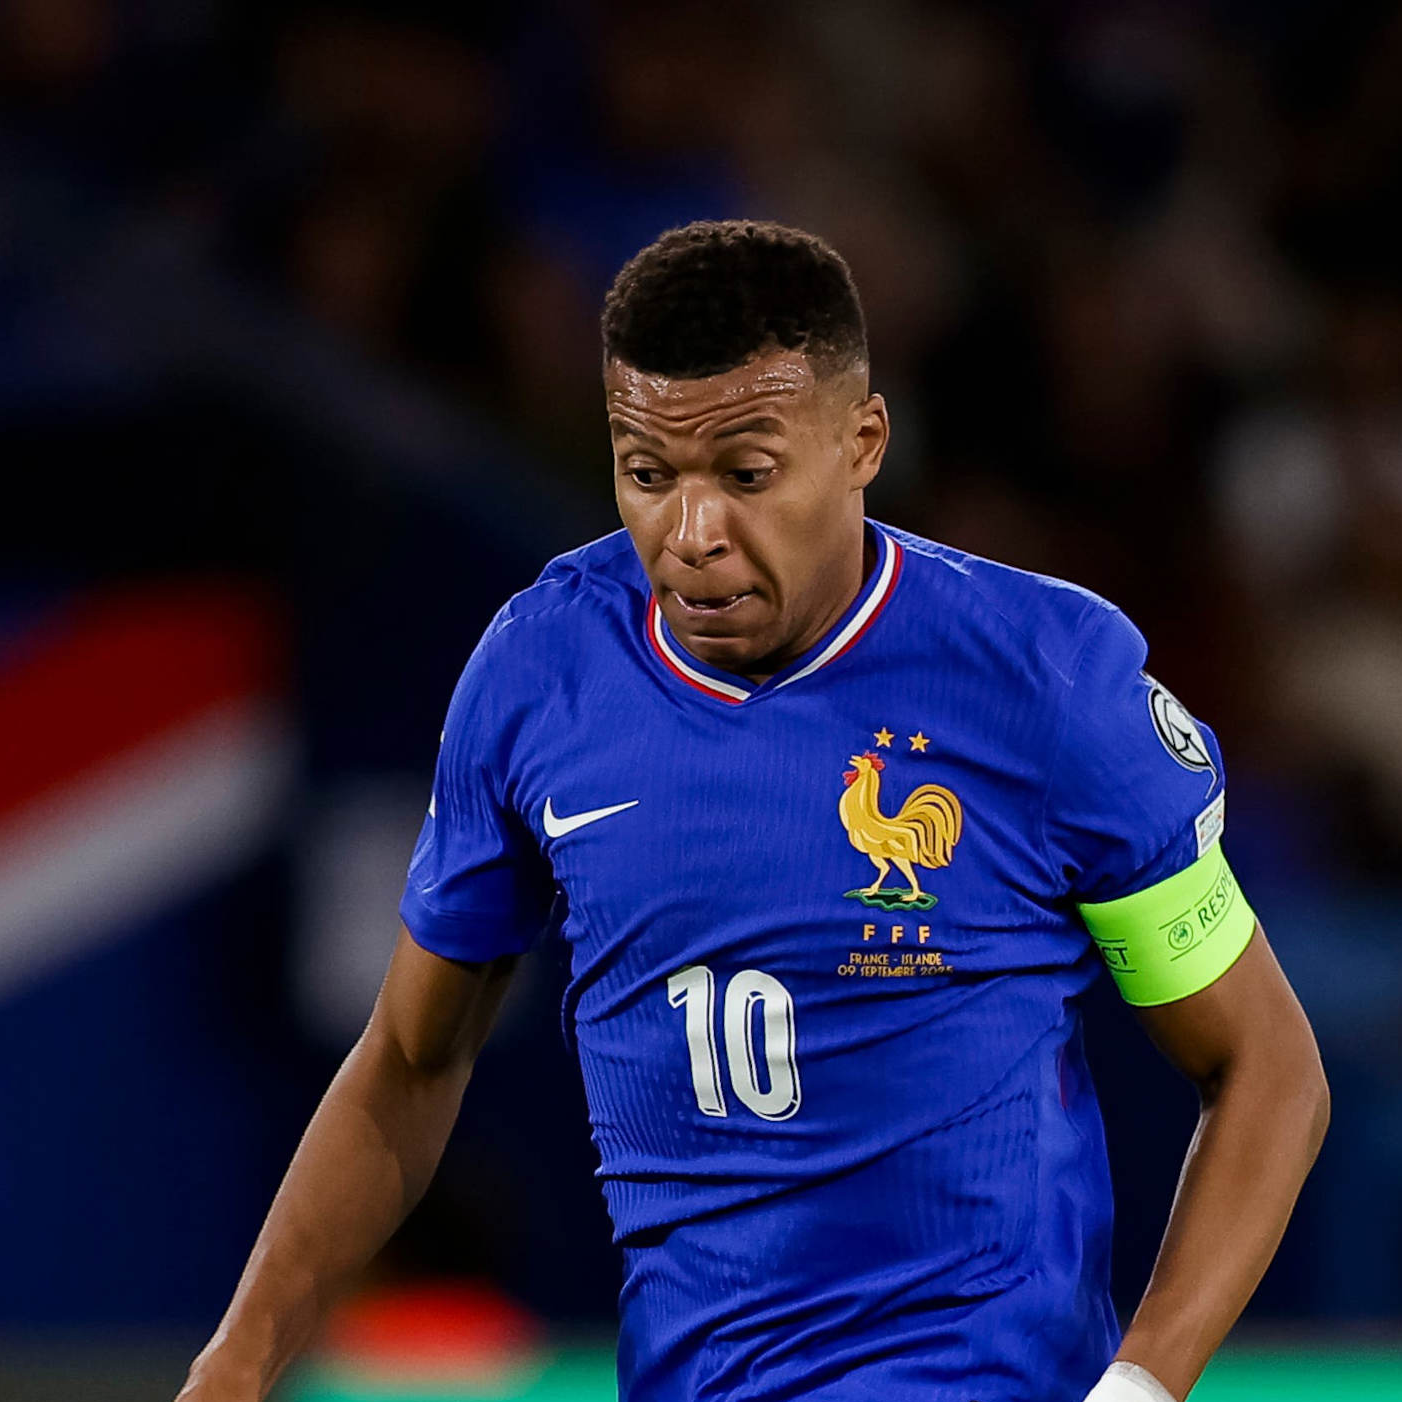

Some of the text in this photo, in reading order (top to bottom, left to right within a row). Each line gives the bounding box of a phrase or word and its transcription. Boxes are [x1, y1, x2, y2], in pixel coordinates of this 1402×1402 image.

[849, 952, 889, 965] FRANCE
[901, 952, 942, 966] ISLANDE
[837, 964, 856, 976] 09
[860, 965, 917, 977] SEPTEMBRE
[667, 965, 802, 1122] 10
